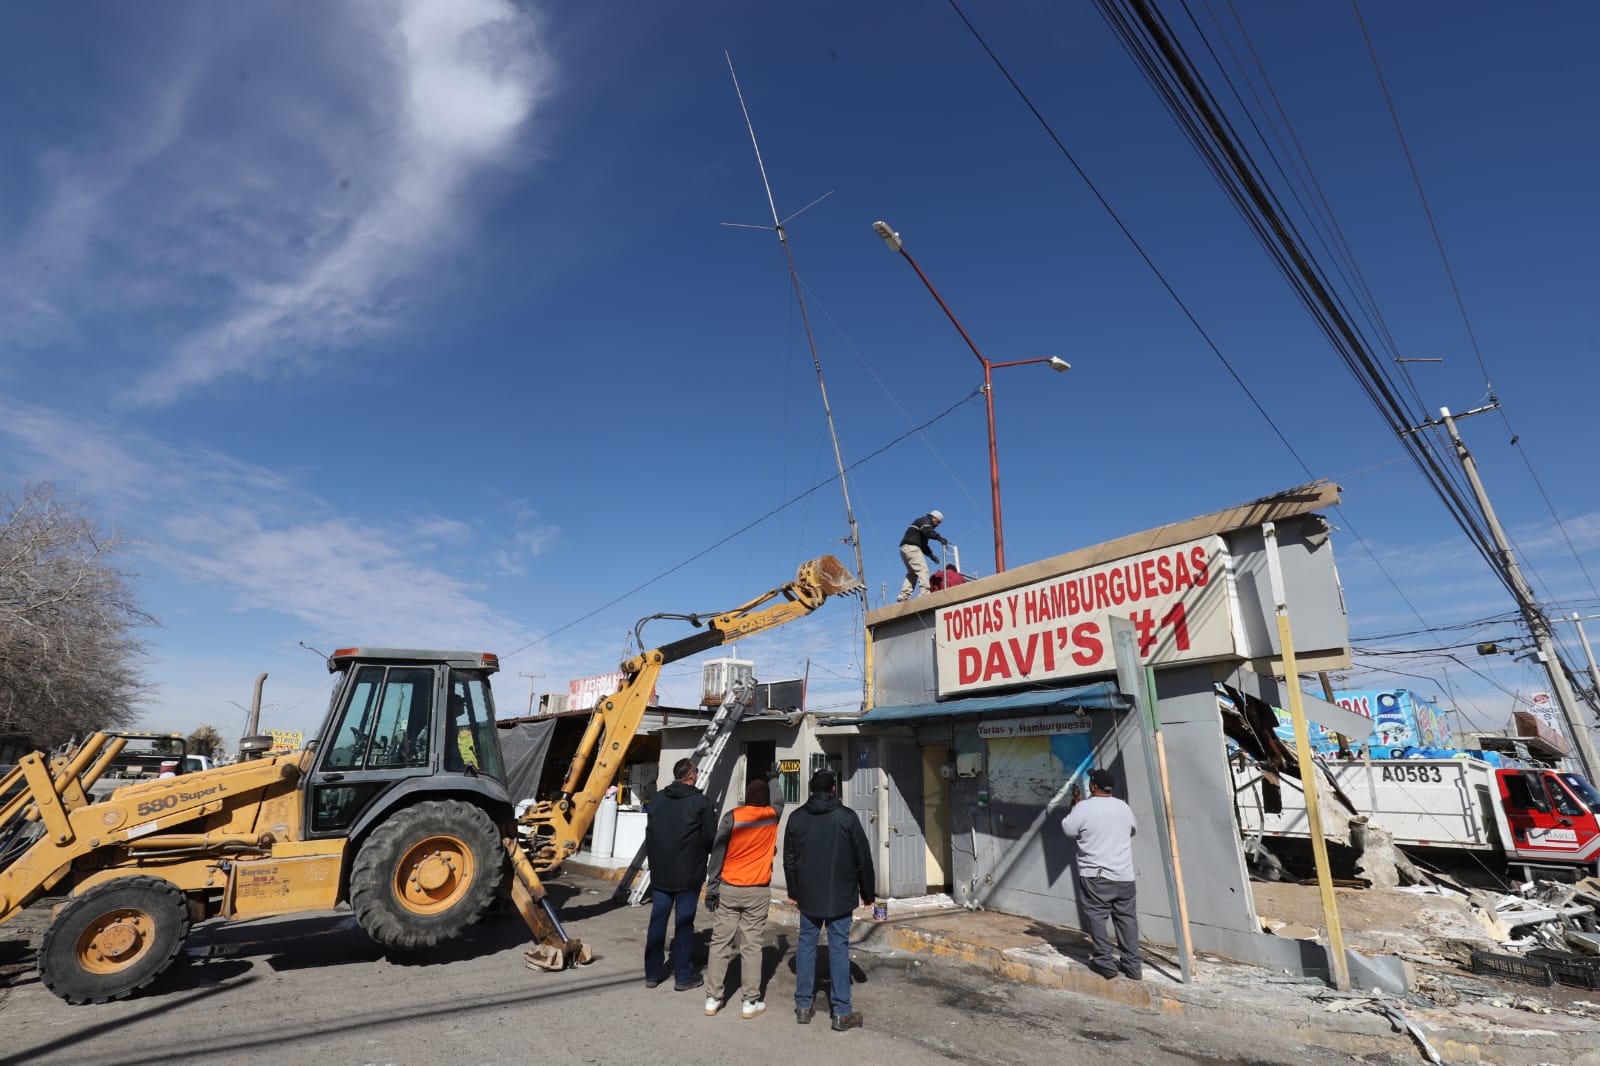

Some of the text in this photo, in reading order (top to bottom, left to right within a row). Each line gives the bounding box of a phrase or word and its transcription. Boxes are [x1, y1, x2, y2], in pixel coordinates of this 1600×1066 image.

[944, 546, 1209, 642] TORTAS Y HAMBURGUESAS
[741, 614, 774, 632] CASE
[958, 621, 1104, 685] DAVI'S
[978, 719, 1092, 734] Tortas y Hamburguesas
[1382, 765, 1442, 782] A0583
[137, 783, 228, 816] 580 Super L
[240, 867, 271, 876] Series
